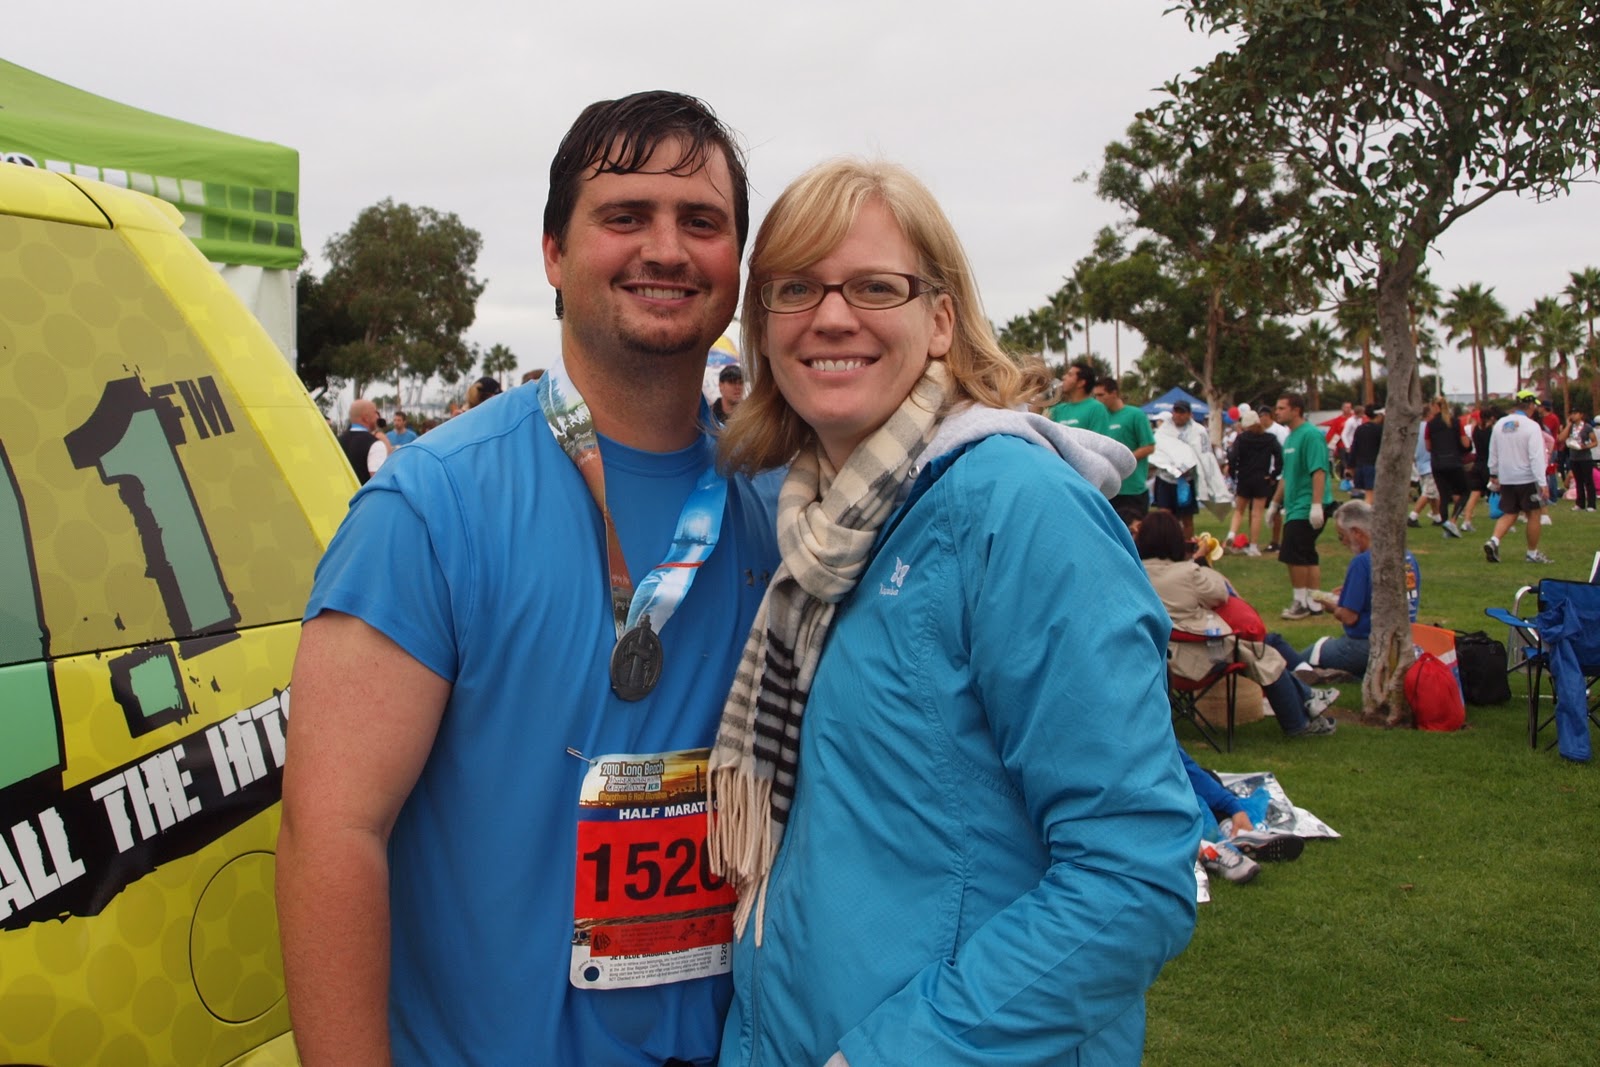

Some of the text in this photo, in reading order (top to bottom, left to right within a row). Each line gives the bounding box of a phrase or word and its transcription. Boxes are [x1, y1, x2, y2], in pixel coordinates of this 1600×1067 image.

[150, 374, 235, 445] FM
[602, 761, 664, 776] 2010 Long Beach
[0, 687, 291, 920] ALL THE HIT
[619, 800, 718, 820] HALF MARAT
[720, 943, 728, 966] 1520
